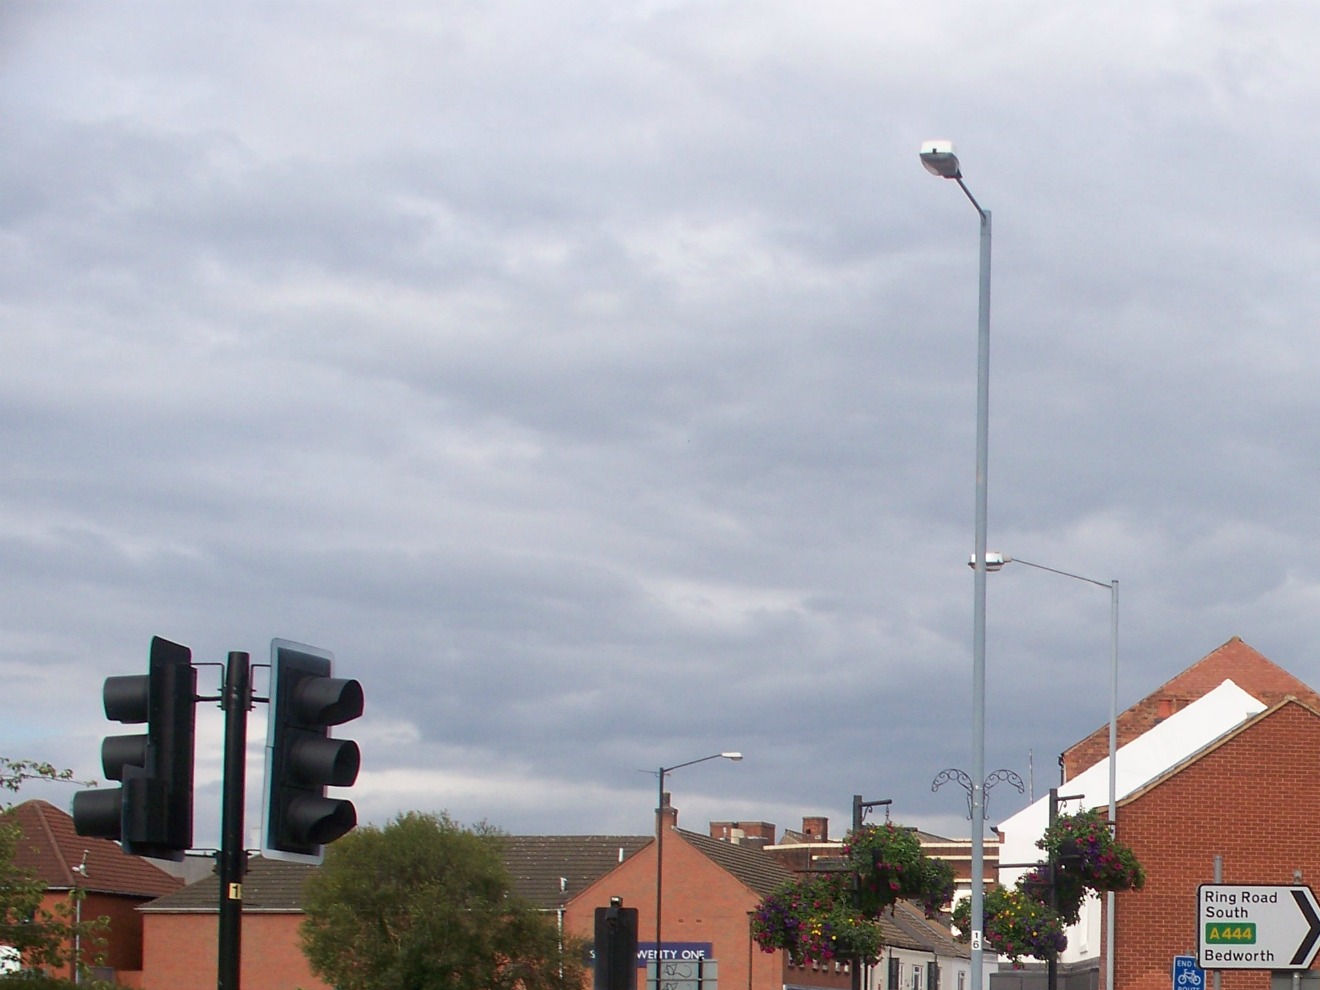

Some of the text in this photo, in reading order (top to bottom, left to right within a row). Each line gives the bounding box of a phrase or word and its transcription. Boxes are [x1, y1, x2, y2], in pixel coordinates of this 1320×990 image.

[1204, 890, 1278, 905] Ring Road
[1205, 906, 1249, 919] South
[637, 950, 706, 960] WENTY ONE
[1204, 949, 1275, 962] Bedworth
[1177, 960, 1193, 968] END
